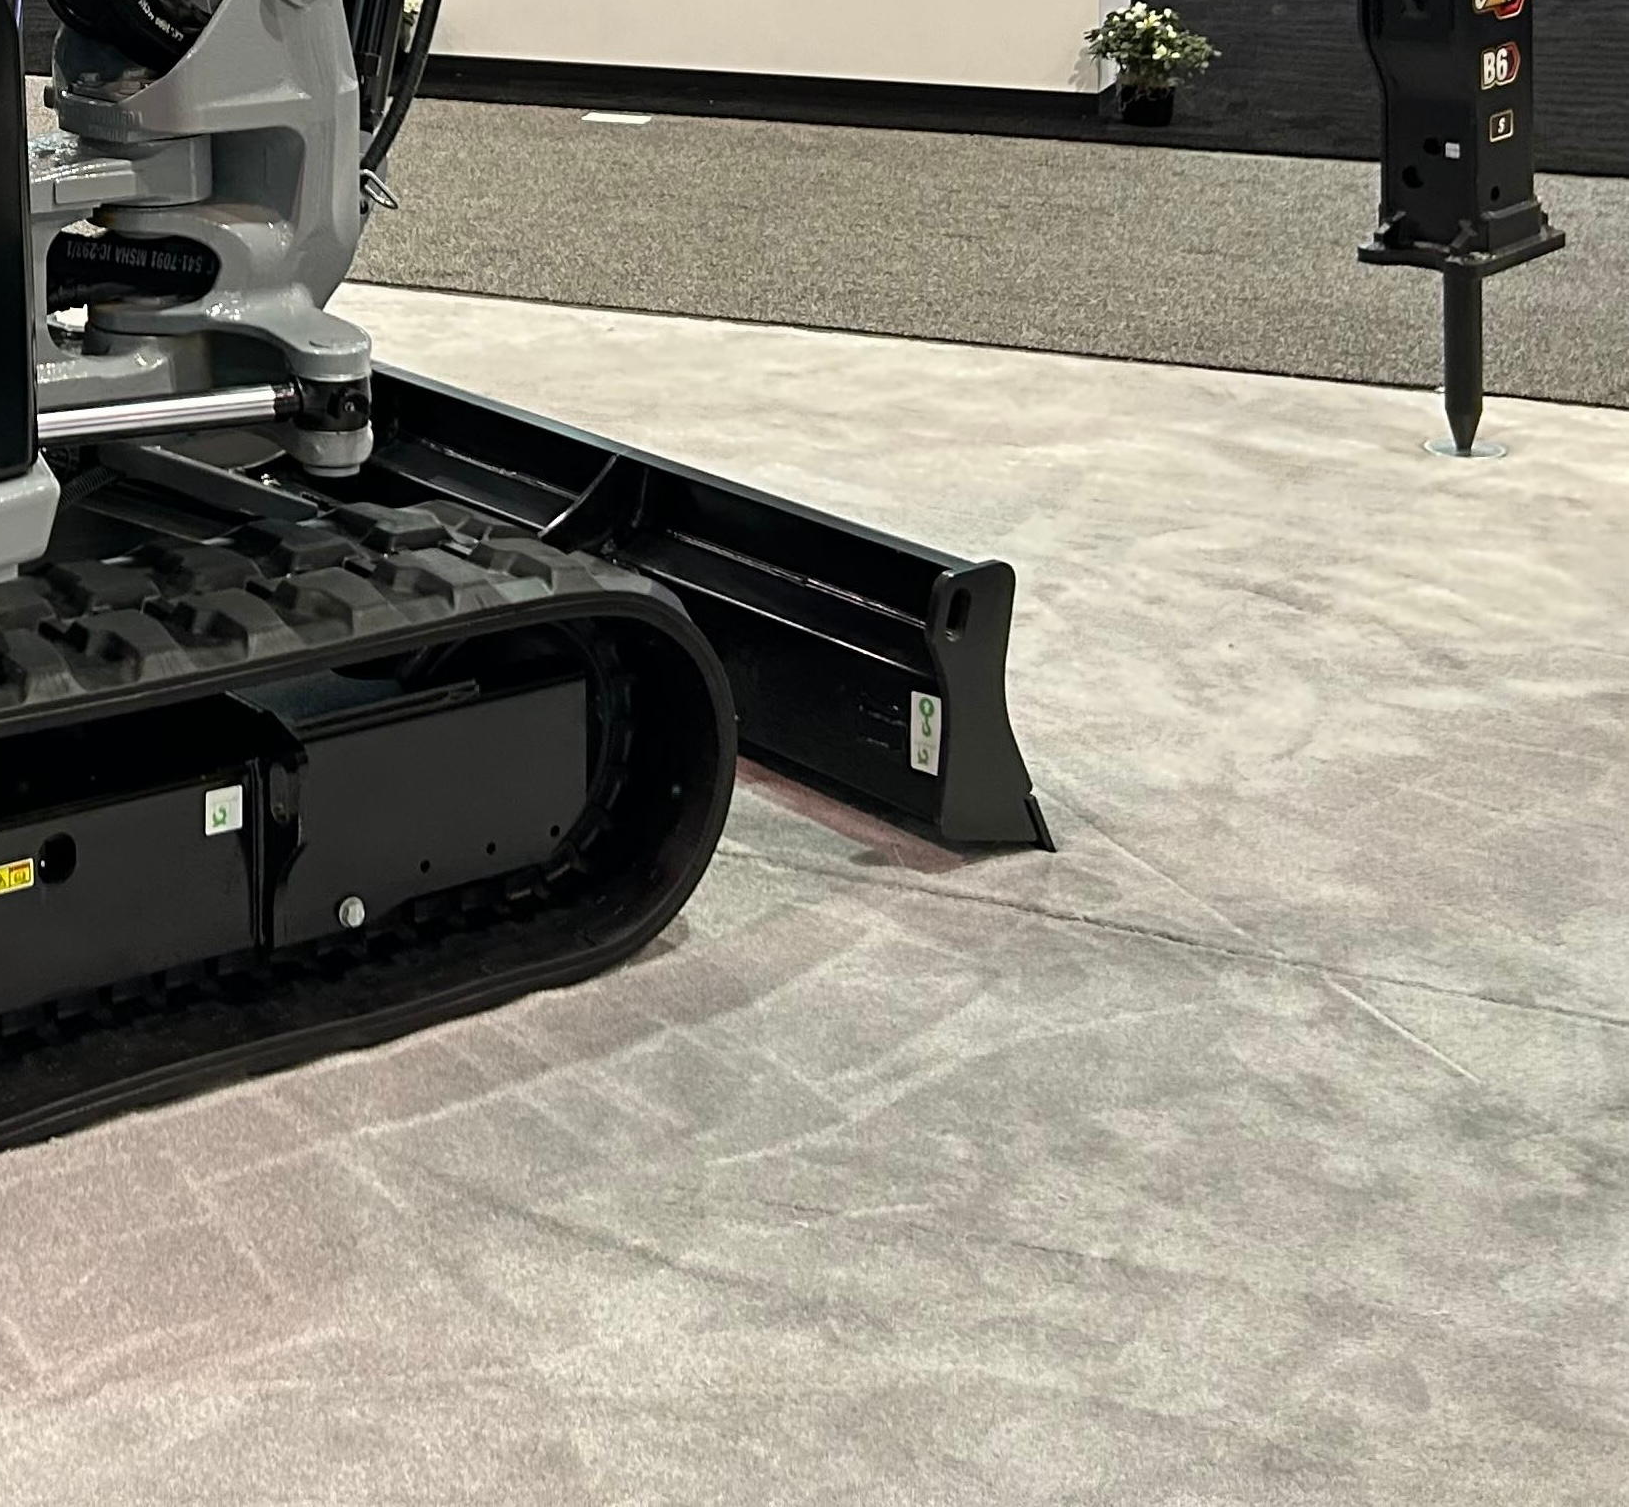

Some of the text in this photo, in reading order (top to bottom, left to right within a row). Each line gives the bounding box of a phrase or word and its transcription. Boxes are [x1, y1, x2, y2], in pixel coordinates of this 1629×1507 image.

[1483, 48, 1508, 85] B6
[1497, 117, 1506, 134] S
[115, 245, 148, 268] MSHA
